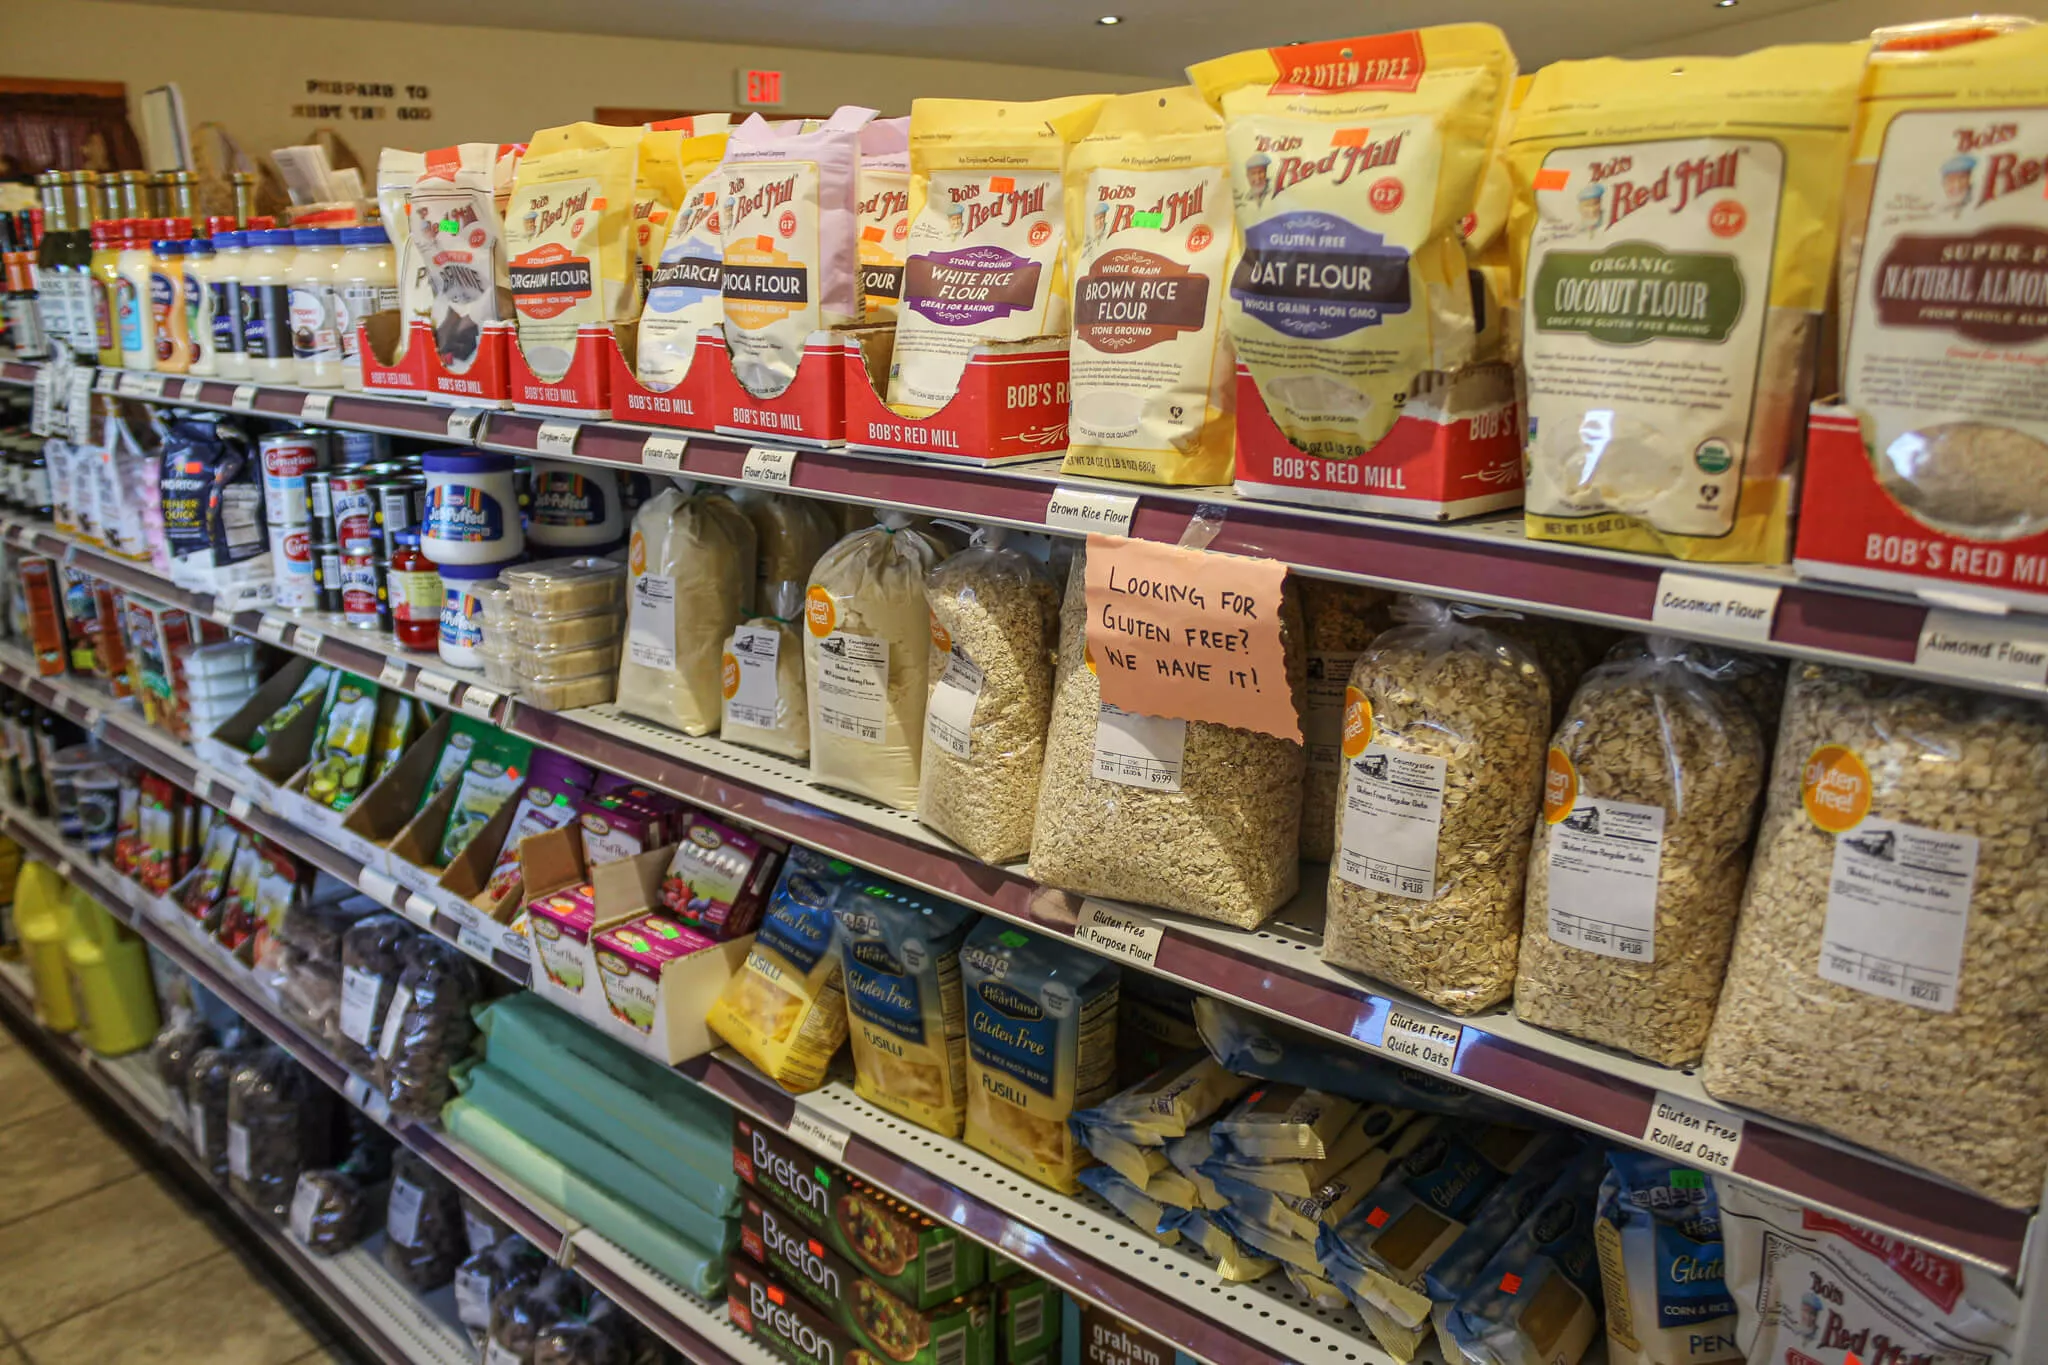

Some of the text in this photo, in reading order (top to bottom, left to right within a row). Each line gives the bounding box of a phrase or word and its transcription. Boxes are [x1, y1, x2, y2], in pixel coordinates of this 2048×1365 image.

[748, 71, 780, 102] EXIT
[1289, 57, 1411, 88] GLUTEN FREE
[1255, 134, 1303, 152] Bob's
[1273, 129, 1404, 199] Red Mill
[734, 174, 795, 230] Red Mill
[948, 183, 980, 204] Bob's
[1098, 185, 1136, 201] Bob's
[1372, 187, 1399, 202] GF
[1605, 146, 1739, 231] Red Mill
[538, 188, 589, 236] Red Mill
[963, 195, 1004, 238] Red
[1002, 183, 1045, 227] Mill
[1160, 181, 1205, 233] Mill
[781, 219, 794, 230] GF
[1031, 230, 1049, 241] GF
[1191, 235, 1209, 246] GF
[1270, 234, 1346, 248] GLUTEN FREE
[672, 266, 720, 284] STARCH
[931, 267, 1014, 287] WHITE RICE
[949, 258, 1012, 269] STONE GROUND
[1102, 265, 1162, 275] WHOLE GRAIN
[1250, 262, 1373, 291] OAT FLOUR
[1590, 256, 1676, 274] ORGANIC
[551, 269, 589, 287] FLOUR
[755, 274, 800, 295] FLOUR
[938, 284, 989, 300] FLOUR
[1085, 281, 1178, 300] BROWN RICE
[1882, 265, 1975, 300] NATURAL
[920, 300, 995, 312] GREAT FOR BAKING
[1098, 302, 1148, 320] FLOUR
[1244, 298, 1377, 319] WHOLE GRAIN NON GMO
[1554, 278, 1709, 319] COCONUT FLOUR
[1961, 309, 2014, 325] WHOLE
[1091, 327, 1152, 336] STONE GROUND
[437, 377, 483, 394] BOB'S RED MILL
[524, 386, 578, 403] BOB'S RED MILL
[1007, 383, 1052, 409] BOB'S
[628, 394, 694, 415] BOB'S RED MILL
[733, 407, 804, 431] BOB'S RED MILL
[1470, 409, 1512, 440] BOB'S
[869, 422, 959, 448] BOB'S RED MILL
[758, 451, 782, 463] Tapioca
[744, 466, 787, 481] Flour/Starch
[1273, 457, 1407, 490] BOB'S RED MILL
[1050, 501, 1129, 525] Brown Rice Flour
[1865, 533, 2004, 578] BOB'S RED
[1109, 565, 1258, 620] LOOKING FOR
[1662, 592, 1767, 620] Coconut Flour
[1102, 603, 1250, 655] GLUTEN FREE?
[1925, 632, 2045, 667] Almond Flour
[1104, 645, 1262, 694] WE HAVE IT!
[1151, 774, 1172, 784] $9.99
[1804, 763, 1862, 795] gluten
[1093, 910, 1145, 938] Gluten Free
[1076, 925, 1153, 961] All Purpose Flour
[885, 983, 913, 1009] Free
[984, 984, 1038, 1017] Heartland
[973, 1011, 1045, 1056] Gluten Free
[1390, 1012, 1457, 1044] Gluten Free
[1386, 1036, 1449, 1067] Quick Oats
[982, 1073, 1027, 1107] FUSILLI
[1657, 1103, 1737, 1142] Gluten Free
[1650, 1128, 1729, 1167] Rolled Oats
[752, 1130, 829, 1217] Breton
[762, 1210, 841, 1299] Breton
[1809, 1271, 1844, 1305] Bob's
[750, 1281, 834, 1365] Breton
[1664, 1305, 1695, 1316] CORN
[1093, 1324, 1160, 1365] graham
[1816, 1308, 1870, 1357] Red
